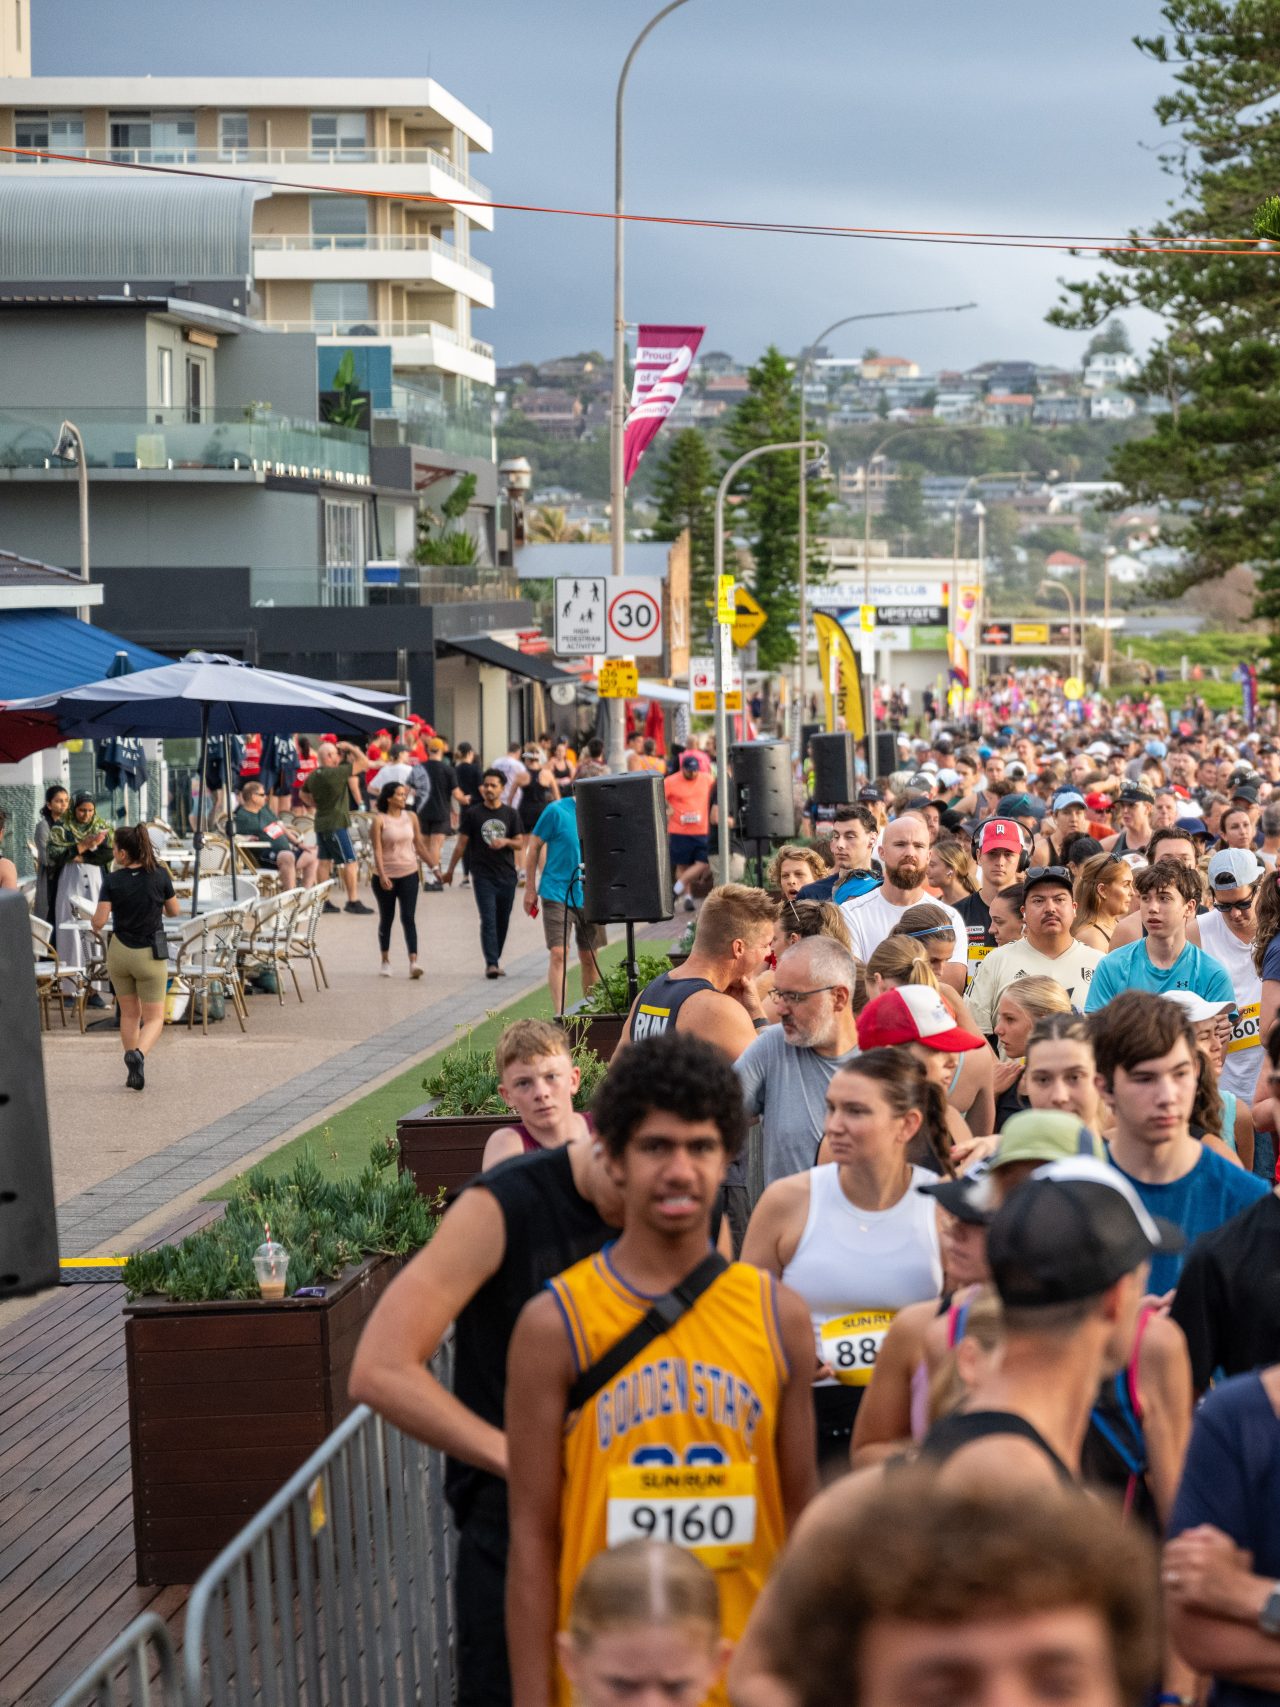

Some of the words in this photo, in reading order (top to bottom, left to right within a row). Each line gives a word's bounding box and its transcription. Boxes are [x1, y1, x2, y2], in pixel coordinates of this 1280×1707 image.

[642, 350, 672, 360] Proud
[895, 584, 927, 596] CLUB
[617, 604, 652, 628] 30
[878, 607, 940, 619] UPSTATE
[633, 1012, 669, 1042] RUN
[842, 1316, 871, 1329] SUN
[596, 1357, 689, 1450] GOLDEN
[641, 1474, 680, 1488] SUN
[683, 1472, 721, 1487] RUN
[631, 1503, 734, 1543] 9160
